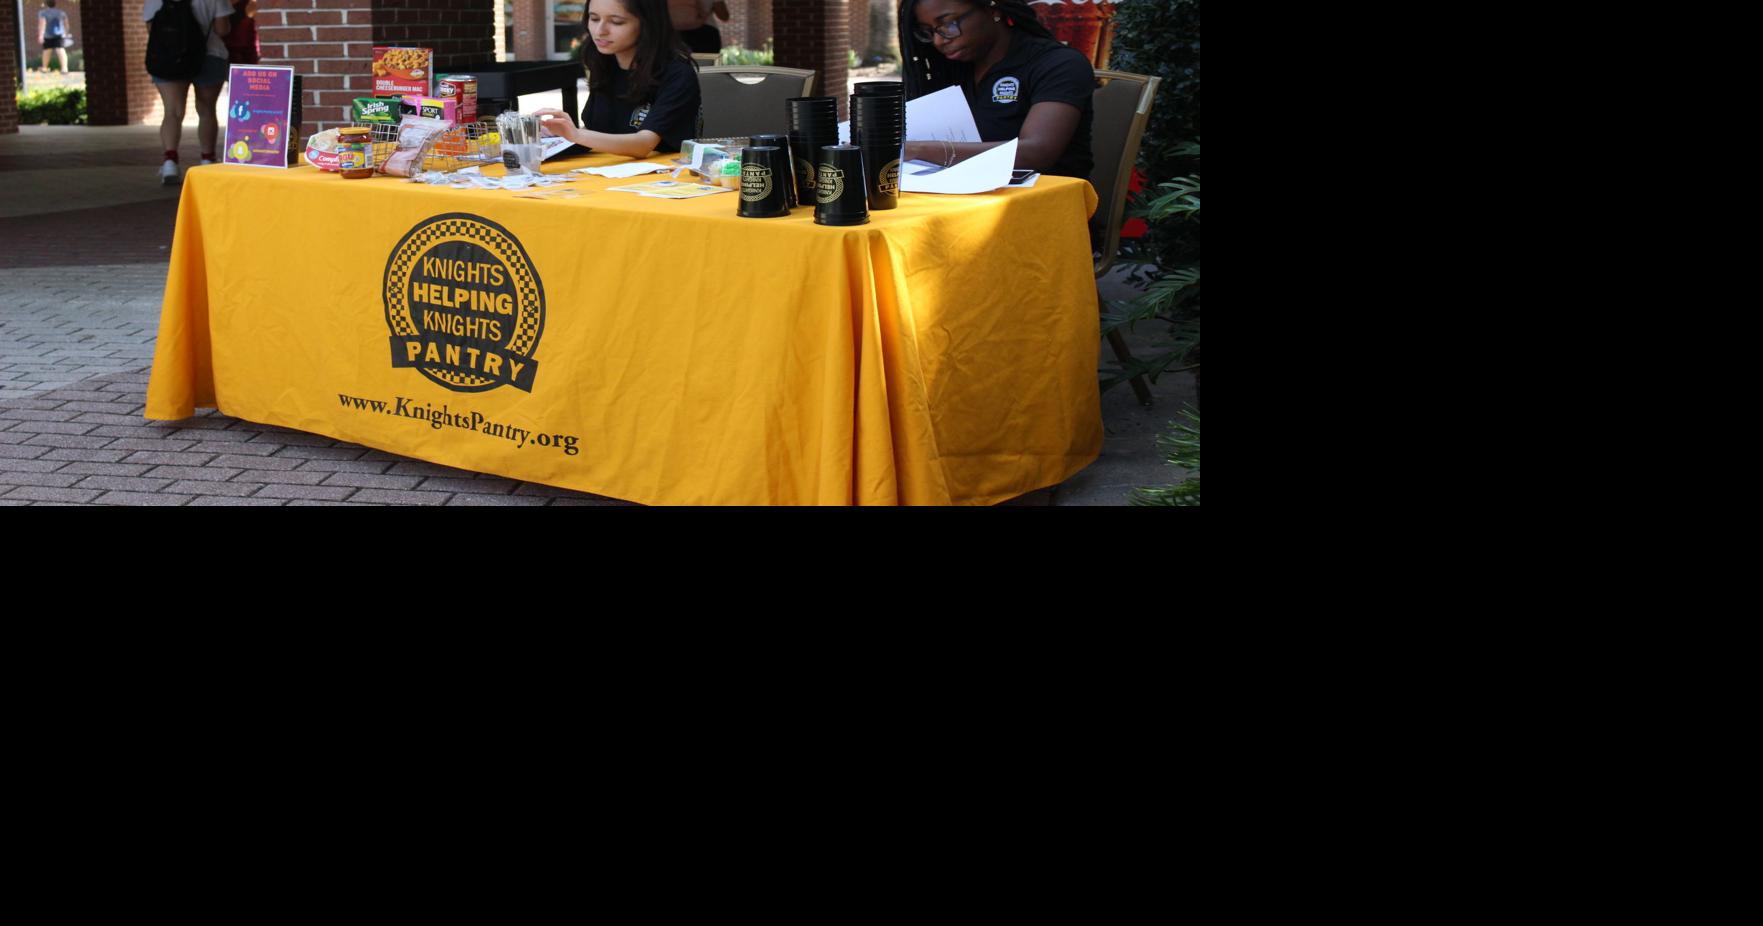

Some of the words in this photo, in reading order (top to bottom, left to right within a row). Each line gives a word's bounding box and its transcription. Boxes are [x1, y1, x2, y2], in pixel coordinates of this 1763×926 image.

[361, 104, 390, 115] Spring
[367, 101, 384, 109] Irish
[421, 106, 438, 114] SPORT
[422, 255, 505, 287] KNIGHTS
[412, 281, 514, 316] HELPING
[422, 309, 503, 342] KNIGHTS
[405, 340, 525, 383] PANTRY
[337, 392, 580, 457] www.KnightsPantry.org
